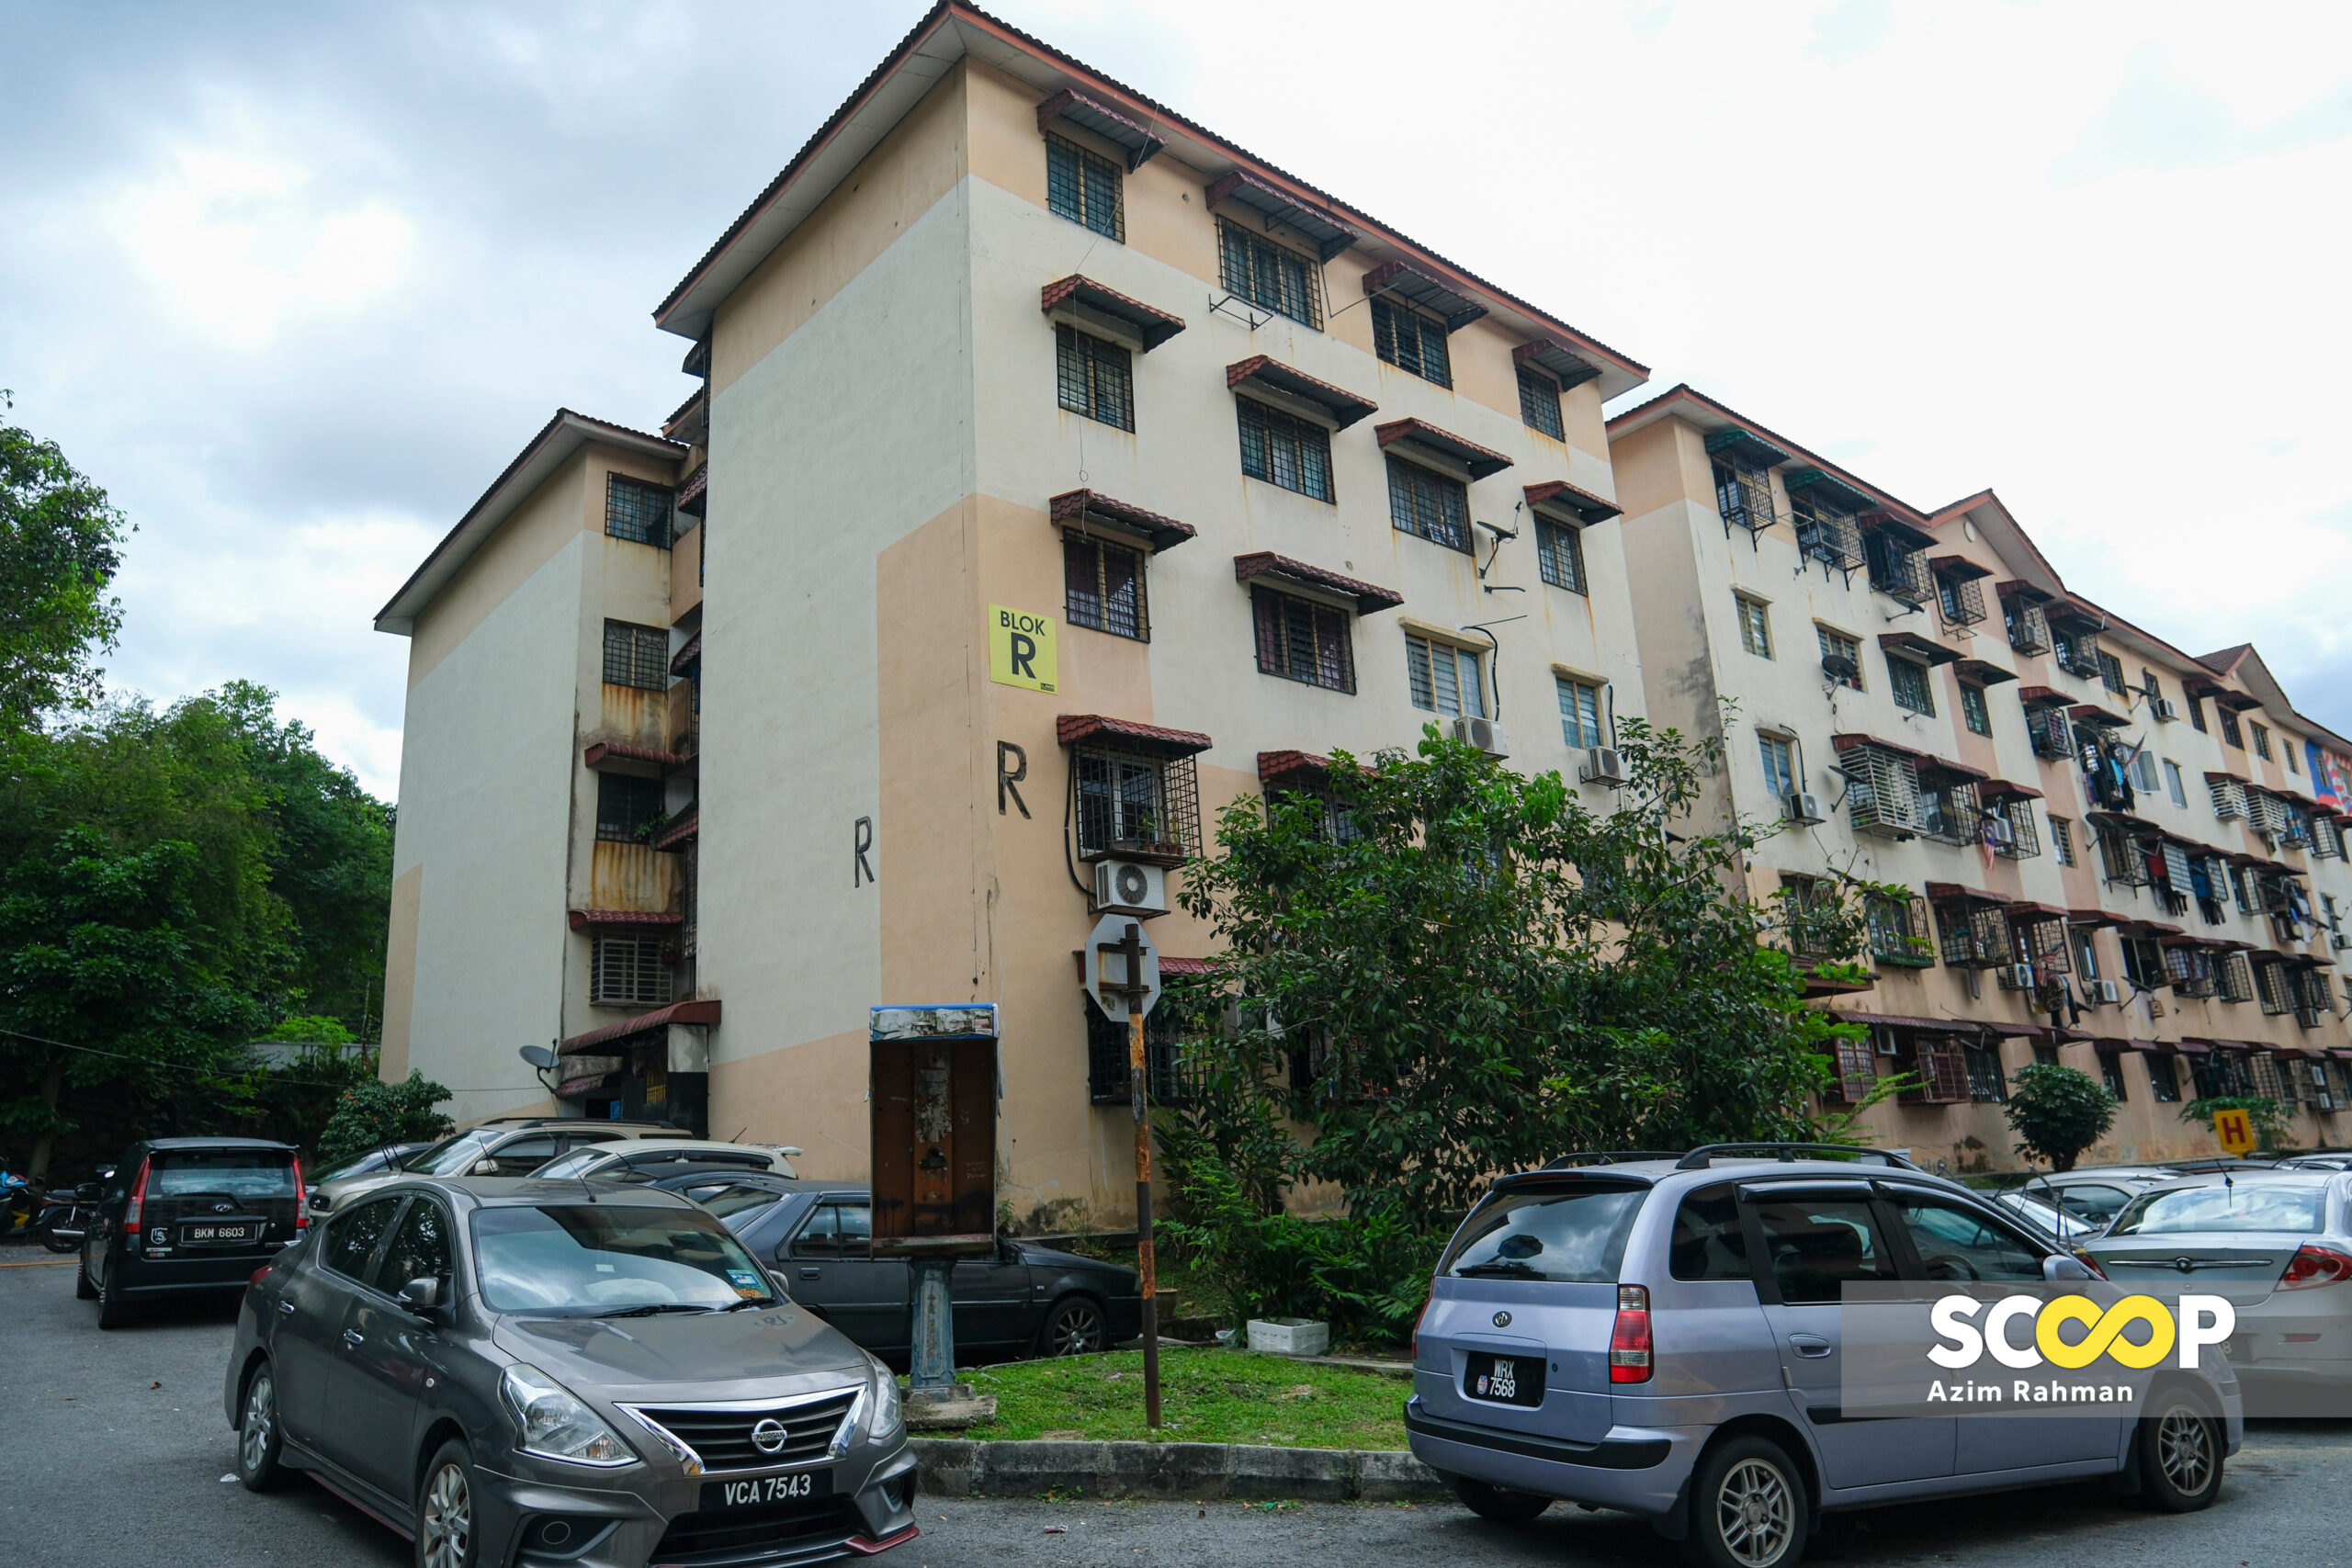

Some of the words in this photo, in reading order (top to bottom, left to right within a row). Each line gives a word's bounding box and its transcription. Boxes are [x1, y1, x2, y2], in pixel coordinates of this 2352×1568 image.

[1000, 610, 1046, 637] BLOK
[1011, 631, 1037, 680] R
[997, 739, 1033, 820] R
[854, 815, 876, 889] R
[2222, 1115, 2246, 1145] H
[194, 1227, 215, 1239] BKM
[219, 1226, 245, 1238] 6603
[1494, 1359, 1515, 1379] WRX
[1489, 1376, 1516, 1398] 7568
[724, 1481, 761, 1506] VCA
[765, 1473, 812, 1501] 7543
